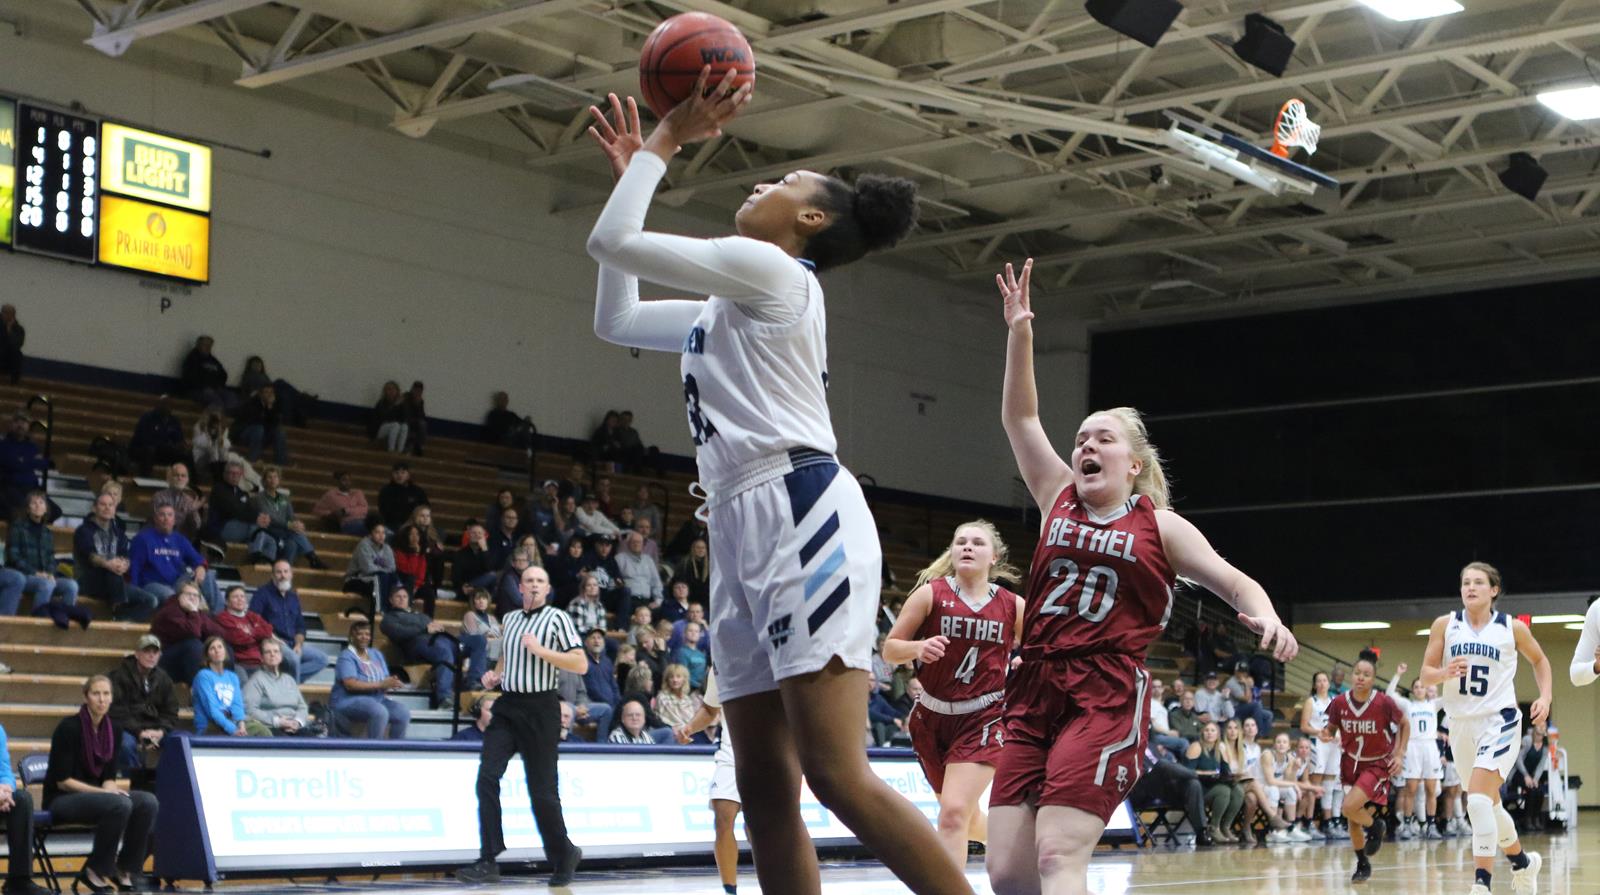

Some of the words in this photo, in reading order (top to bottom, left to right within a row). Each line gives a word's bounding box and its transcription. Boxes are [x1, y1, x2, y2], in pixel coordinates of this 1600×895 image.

[134, 144, 179, 172] BUD
[126, 160, 186, 193] LIGHT
[116, 229, 160, 257] PRAIRIE
[163, 243, 193, 270] BAND
[160, 297, 171, 314] P
[1045, 517, 1137, 563] BETHEL
[1040, 557, 1119, 623] 20
[940, 615, 1004, 645] BETHEL
[954, 646, 979, 684] 4
[1450, 642, 1500, 662] WASHBURN
[1458, 664, 1489, 697] 15
[1418, 719, 1427, 733] 0
[236, 767, 364, 800] Darrell's
